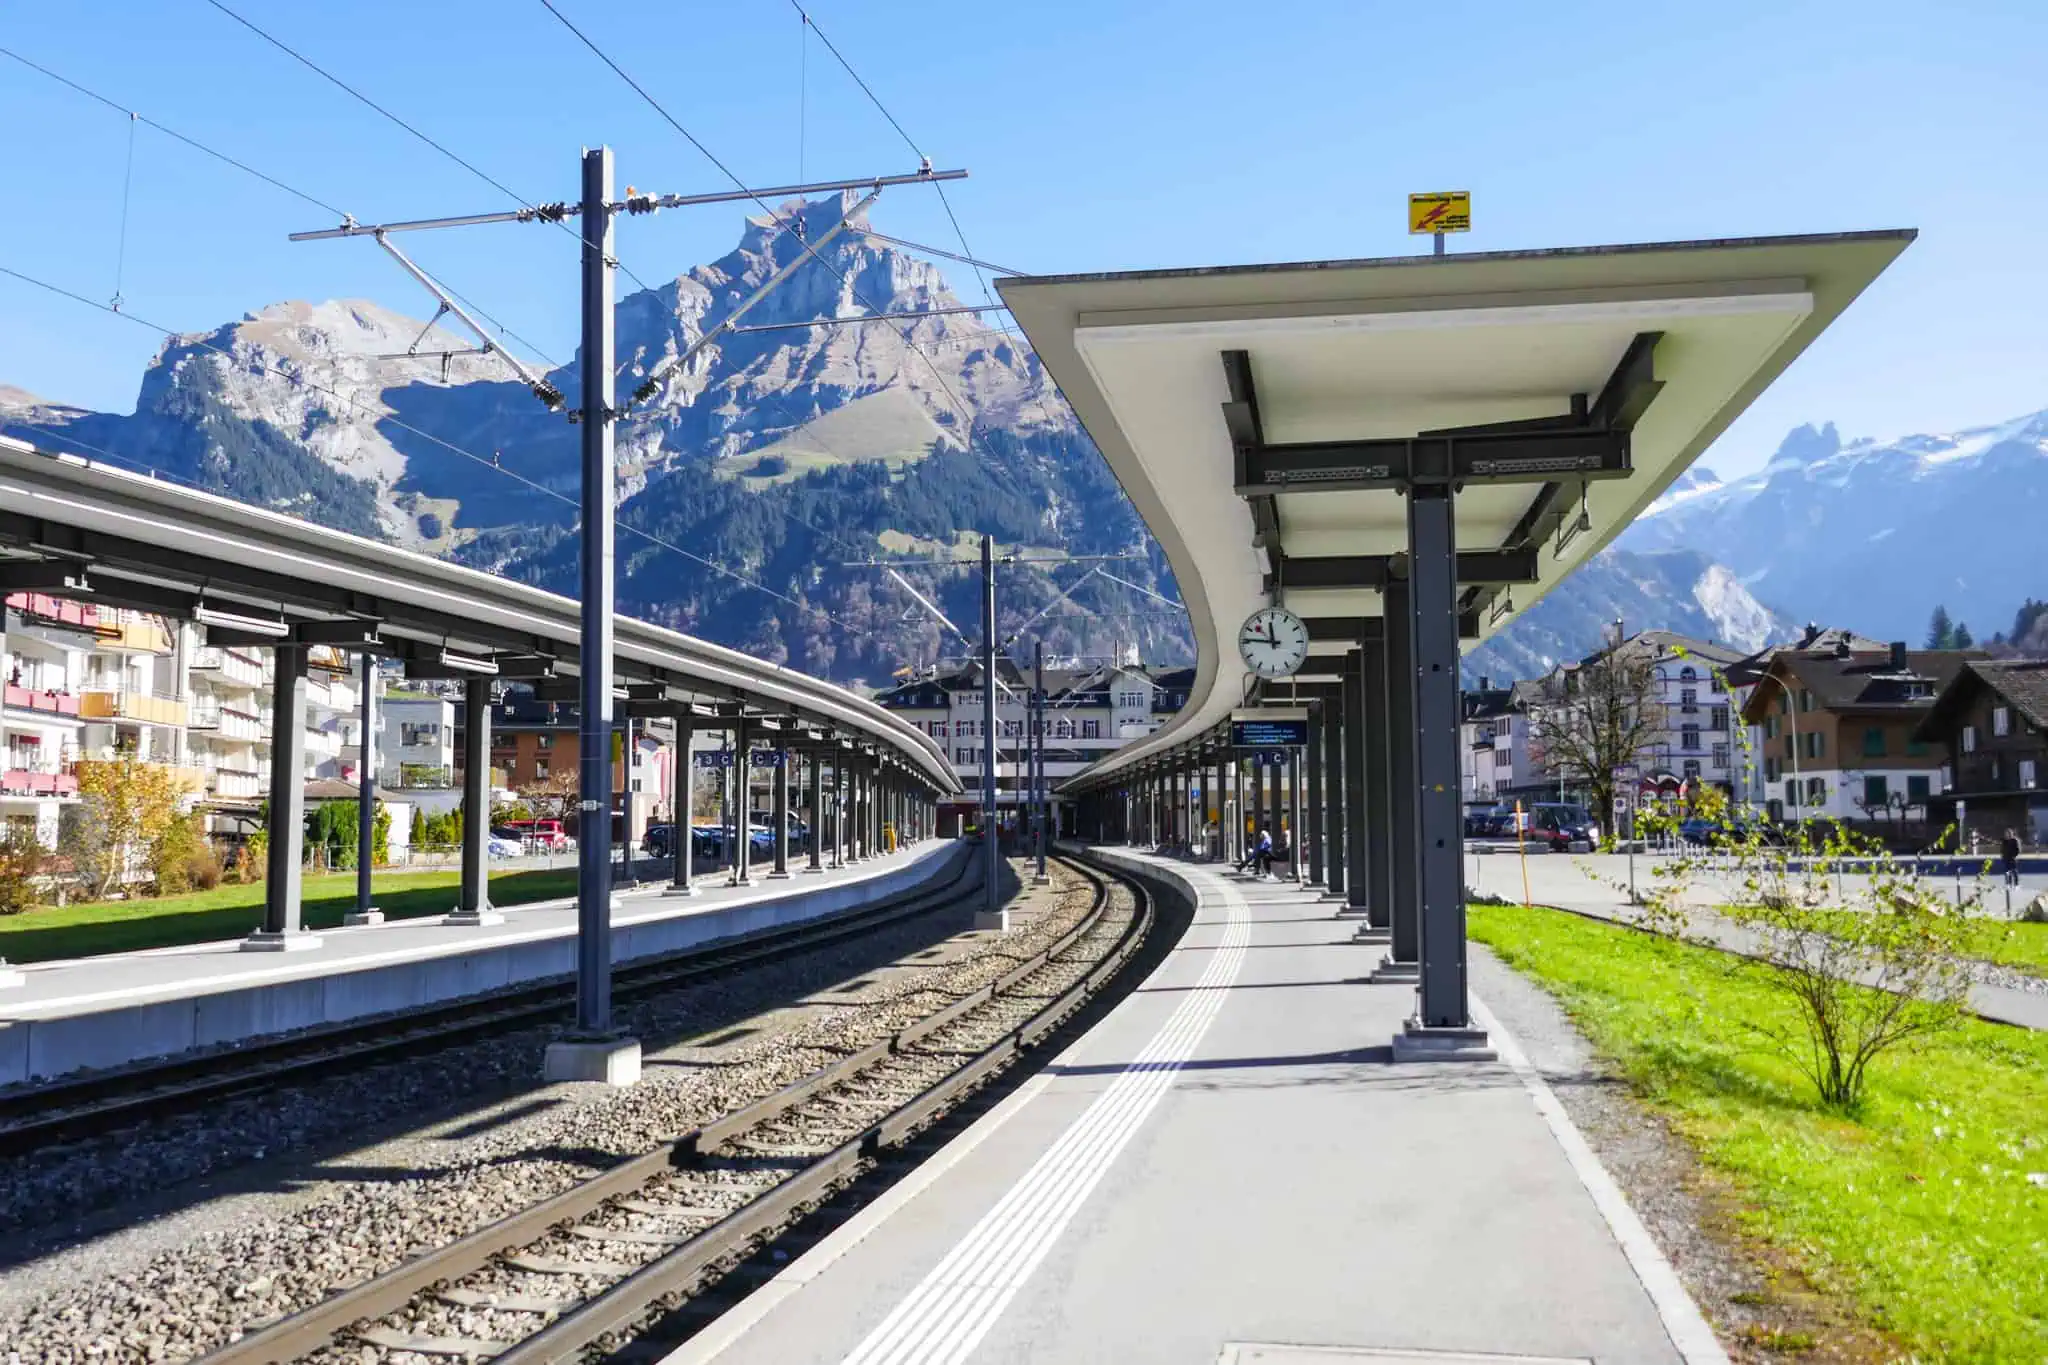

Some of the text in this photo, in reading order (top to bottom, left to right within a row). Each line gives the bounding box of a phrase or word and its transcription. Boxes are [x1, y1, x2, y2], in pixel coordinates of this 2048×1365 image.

[705, 755, 729, 765] 3 C
[756, 755, 780, 765] C 2
[1274, 753, 1282, 763] C
